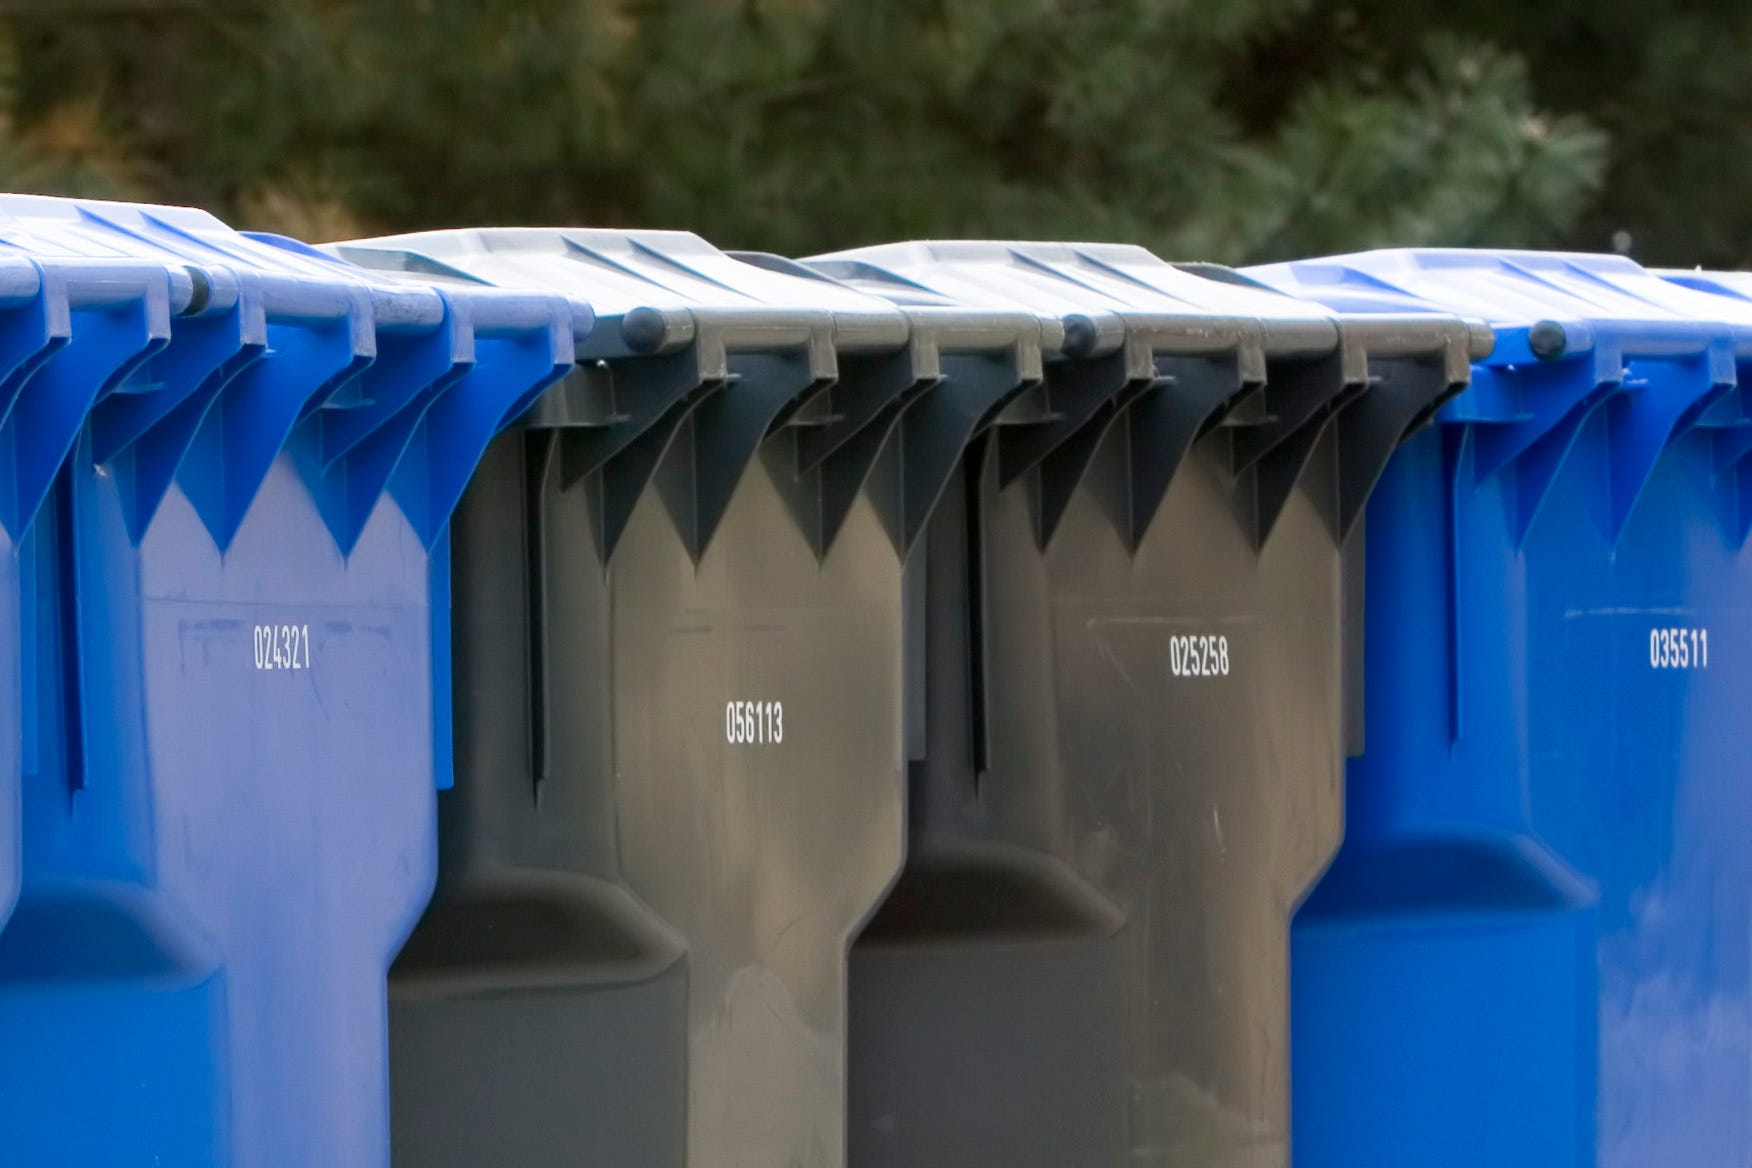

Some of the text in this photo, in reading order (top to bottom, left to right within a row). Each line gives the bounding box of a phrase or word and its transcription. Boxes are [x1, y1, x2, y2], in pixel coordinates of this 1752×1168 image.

[254, 624, 310, 670] 024321
[1170, 635, 1230, 676] 025258
[1650, 628, 1708, 668] 035511
[726, 701, 783, 744] 056113
